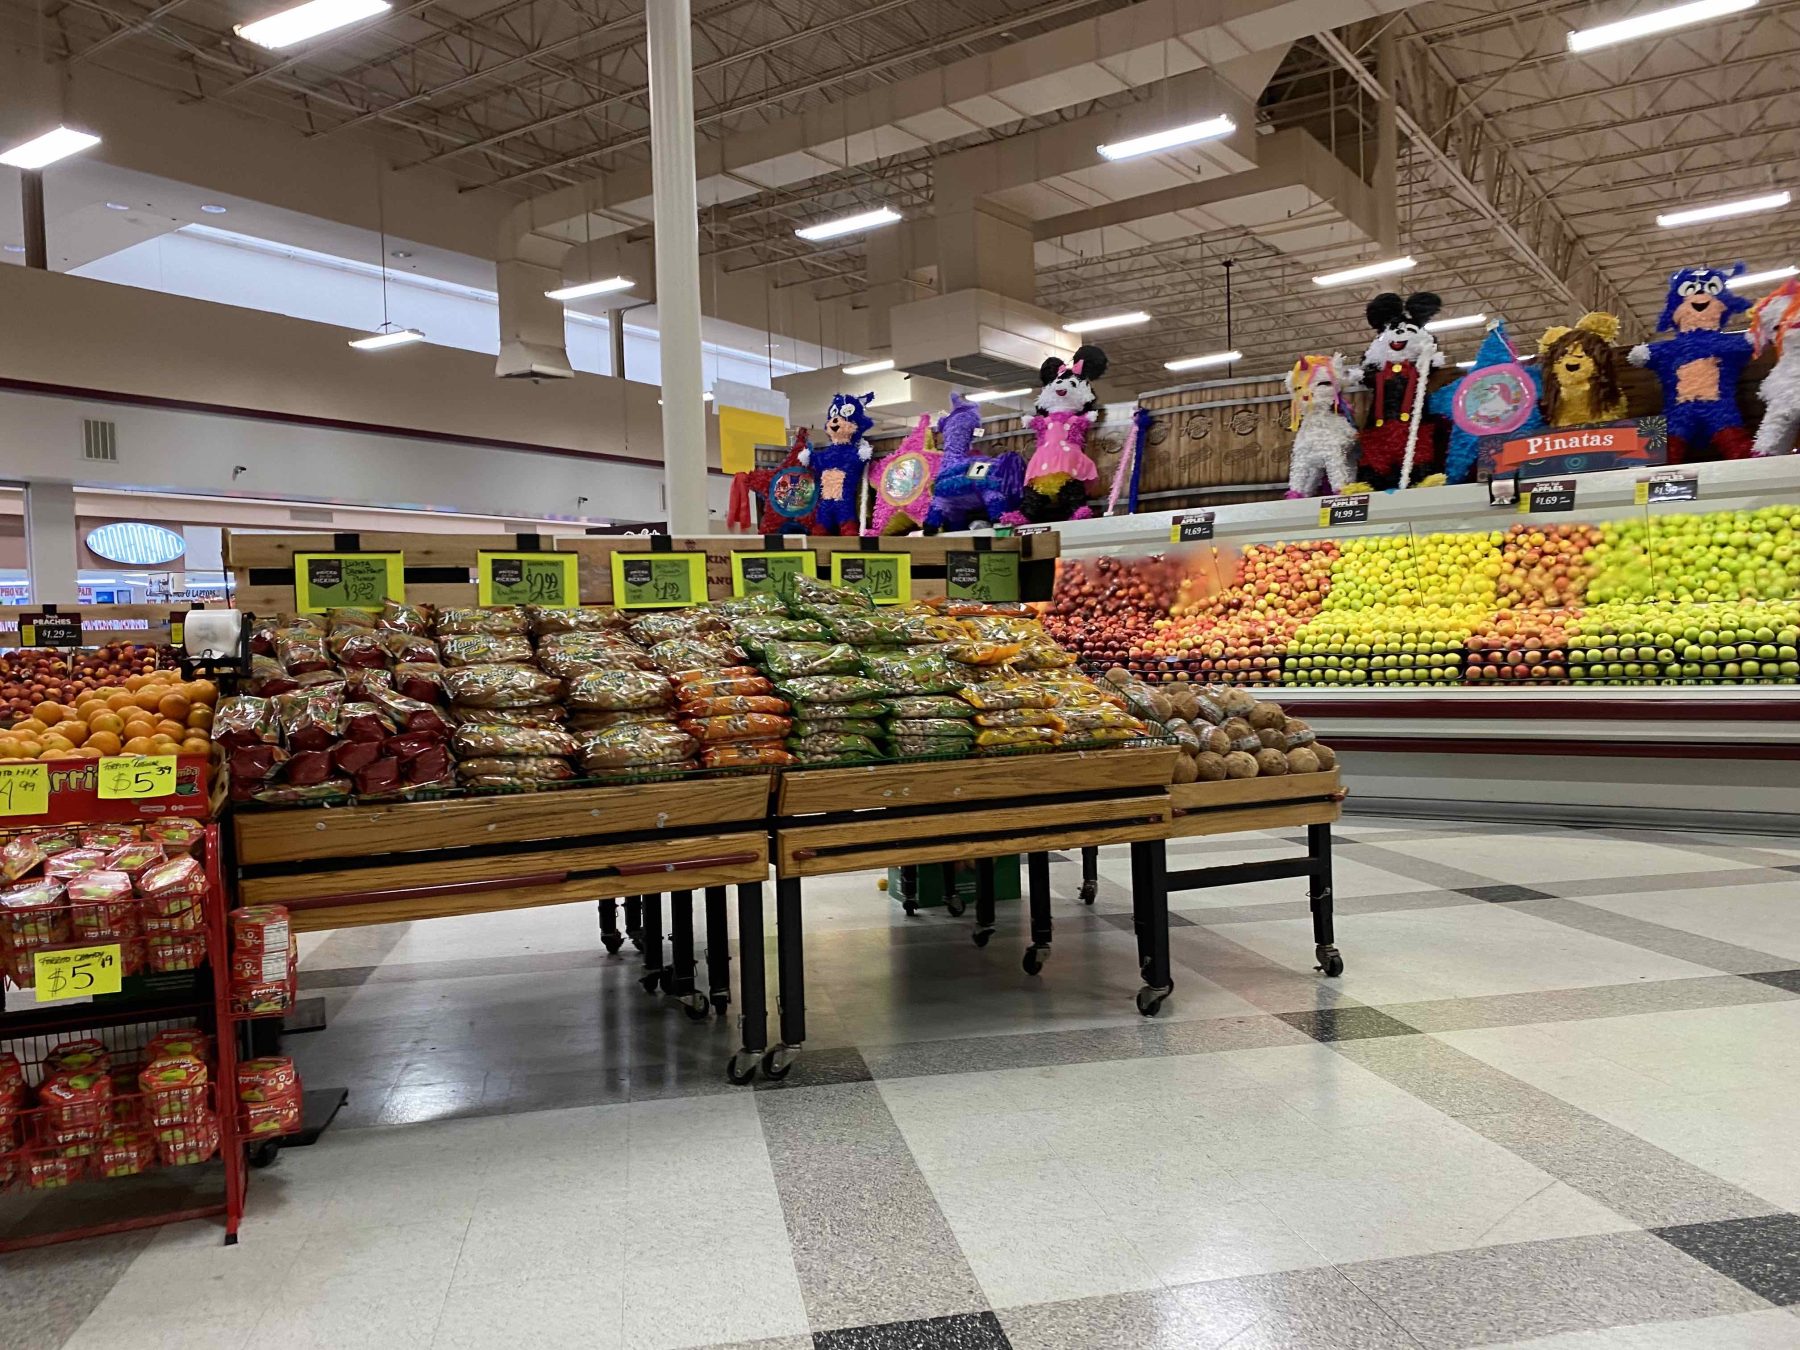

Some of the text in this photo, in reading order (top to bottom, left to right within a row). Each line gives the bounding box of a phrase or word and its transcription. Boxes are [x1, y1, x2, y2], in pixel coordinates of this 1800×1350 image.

[1526, 432, 1614, 455] Pinatas
[1531, 485, 1564, 493] APPLES
[1331, 500, 1359, 508] APPLES
[1535, 495, 1558, 505] $1.69
[1334, 509, 1354, 518] $1.99
[1184, 526, 1202, 535] $1.69
[77, 587, 93, 597] PAIR
[32, 618, 72, 626] PEACHES
[42, 629, 65, 639] $1.29
